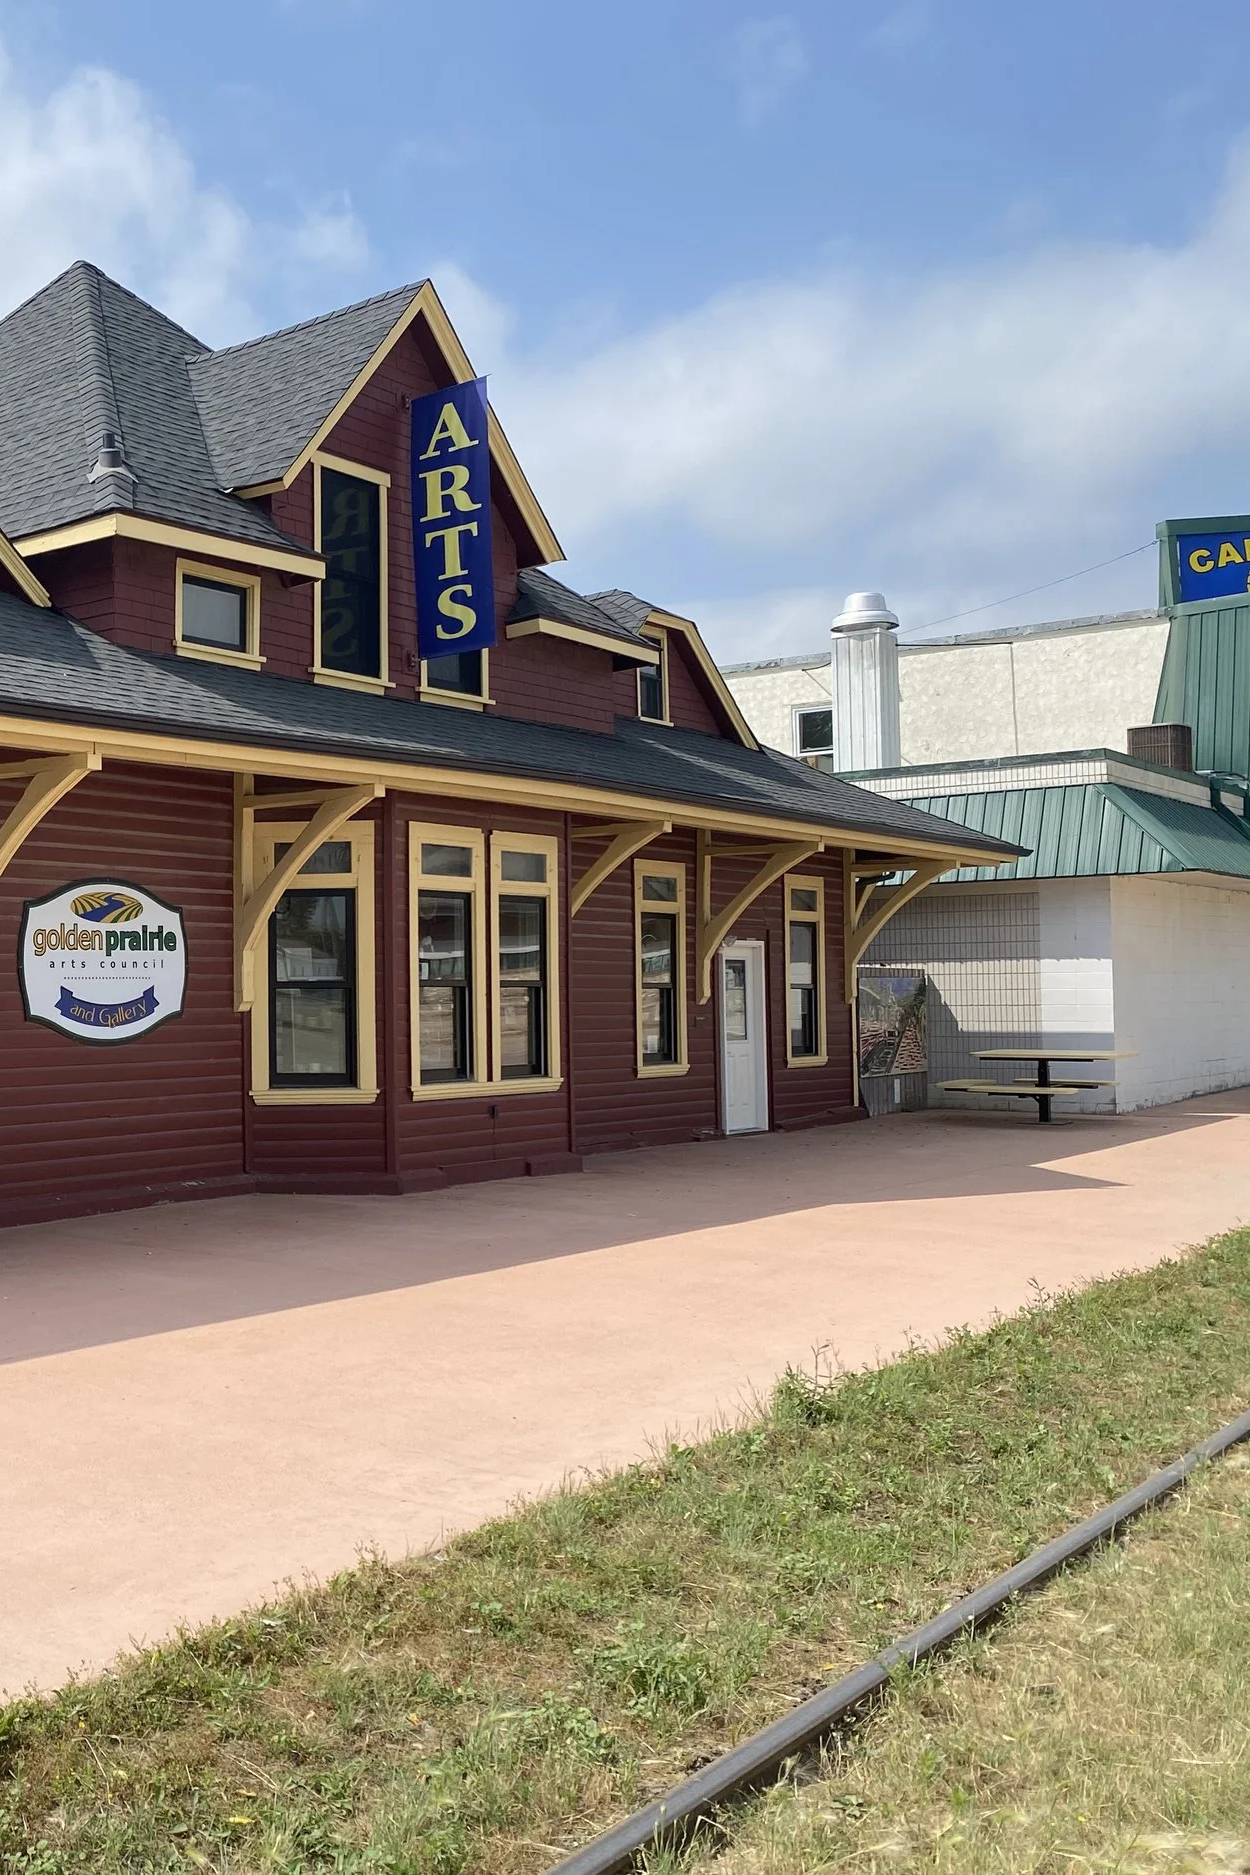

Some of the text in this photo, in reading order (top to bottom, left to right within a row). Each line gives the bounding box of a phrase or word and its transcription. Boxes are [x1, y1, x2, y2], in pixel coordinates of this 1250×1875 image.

[419, 402, 483, 640] ARTS
[1189, 538, 1250, 573] CA
[33, 923, 177, 957] golden prairie
[49, 959, 164, 969] arts council
[70, 999, 148, 1028] and Gallery
